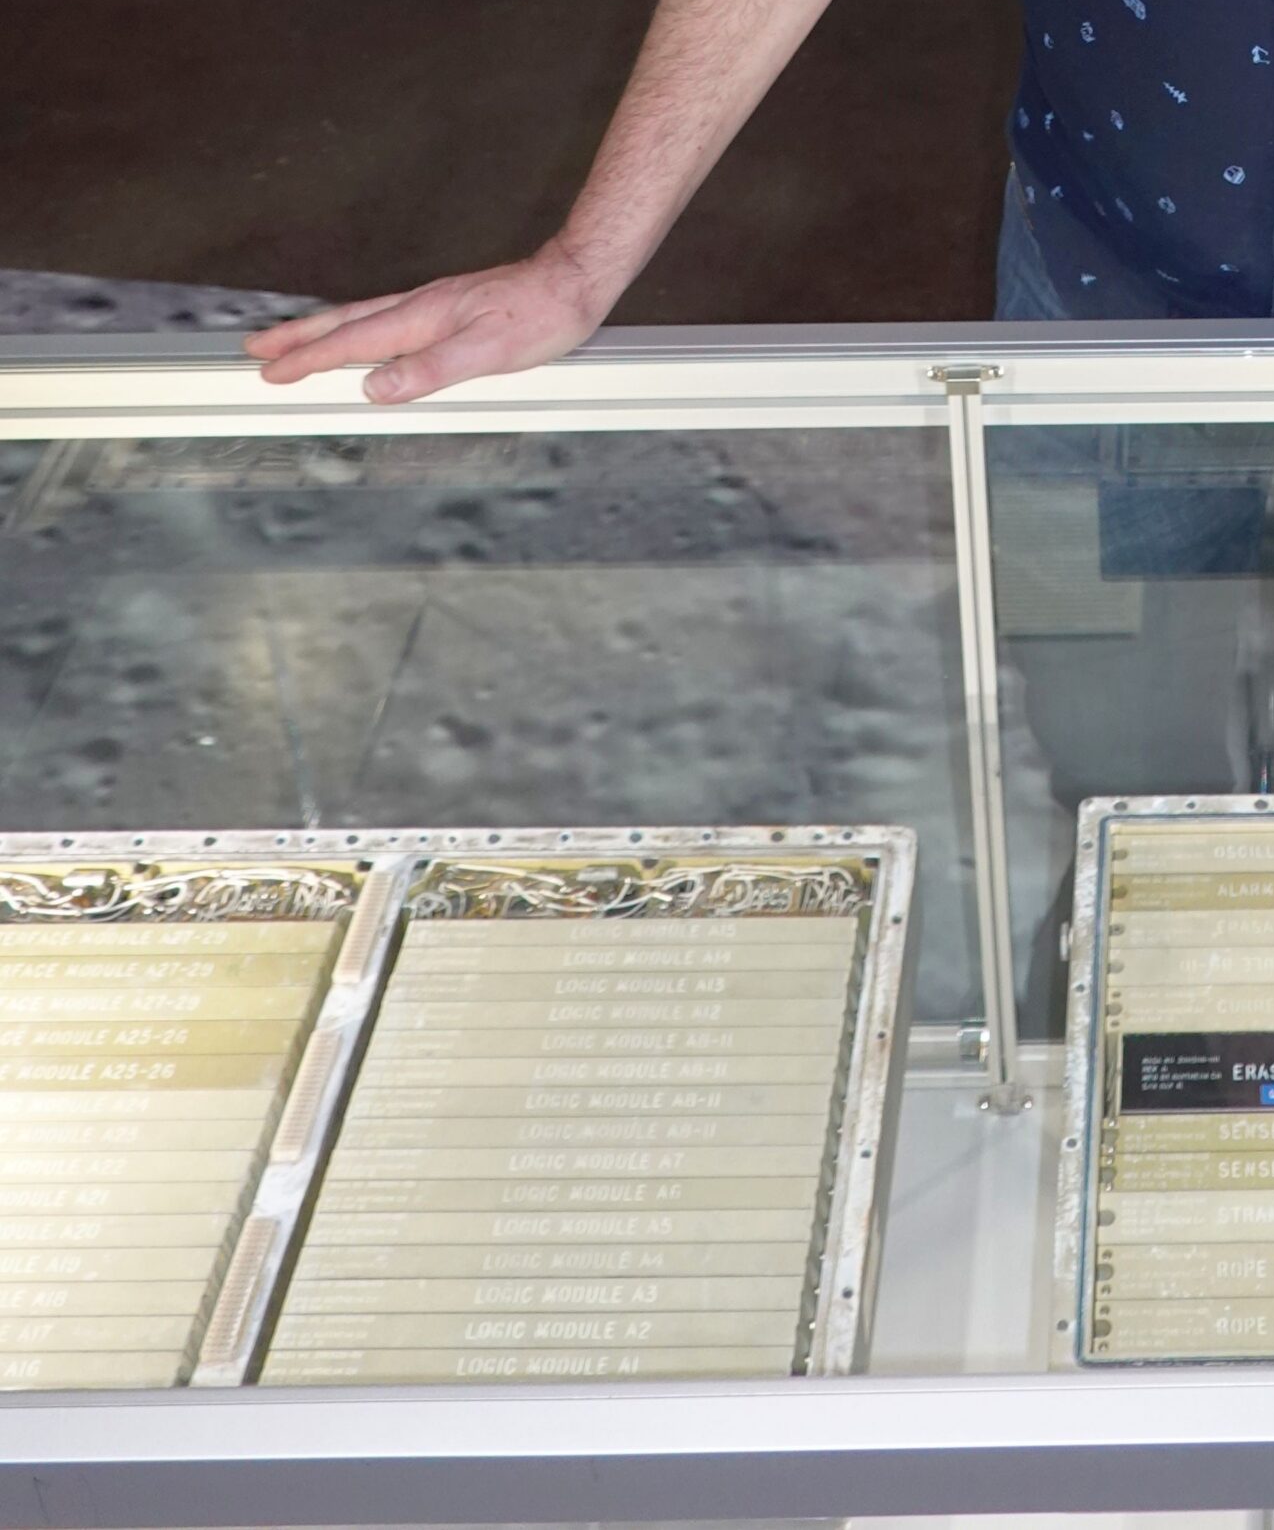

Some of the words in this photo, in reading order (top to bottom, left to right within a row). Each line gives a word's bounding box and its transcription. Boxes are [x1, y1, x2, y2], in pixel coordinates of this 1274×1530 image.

[1216, 882, 1274, 897] ALARM
[80, 929, 156, 945] MODULE
[563, 951, 617, 966] LOGIC
[622, 950, 694, 966] MODULE
[66, 962, 138, 979] MODULE
[554, 979, 609, 994] LOGIC
[615, 977, 687, 993] MODULE
[694, 977, 727, 991] A13
[49, 995, 123, 1011] MODULE
[547, 1006, 603, 1022] LOGIC
[609, 1004, 682, 1020] MODULE
[32, 1029, 110, 1046] MODULE
[541, 1034, 597, 1050] LOGIC
[602, 1032, 677, 1049] MODULE
[17, 1062, 95, 1080] MODULE
[533, 1062, 588, 1079] LOGIC
[596, 1060, 671, 1078] MODULE
[525, 1092, 580, 1109] LOGIC
[587, 1091, 663, 1109] MODULE
[86, 1157, 129, 1175] A22
[509, 1153, 566, 1171] LOGIC
[572, 1152, 649, 1171] MODULE
[657, 1152, 685, 1169] A7
[73, 1189, 112, 1206] A21
[502, 1184, 559, 1203] LOGIC
[569, 1184, 647, 1202] MODULE
[656, 1184, 682, 1200] A6
[492, 1218, 550, 1237] LOGIC
[559, 1217, 637, 1235] MODULE
[646, 1218, 673, 1235] A5
[482, 1252, 542, 1271] LOGIC
[550, 1251, 632, 1270] MODULE
[638, 1251, 665, 1269] A4
[1216, 1259, 1267, 1278] ROPE
[31, 1290, 70, 1308] A18
[474, 1285, 532, 1305] LOGIC
[542, 1285, 623, 1304] MODULE
[632, 1285, 658, 1303] A3
[16, 1324, 55, 1343] A17
[465, 1321, 525, 1340] LOGIC
[534, 1320, 616, 1340] MODULE
[624, 1321, 653, 1340] A2
[1216, 1315, 1268, 1336] ROPE
[3, 1359, 42, 1378] A16
[456, 1356, 517, 1376] LOGIC
[526, 1356, 608, 1375] MODULE
[618, 1356, 640, 1374] A1
